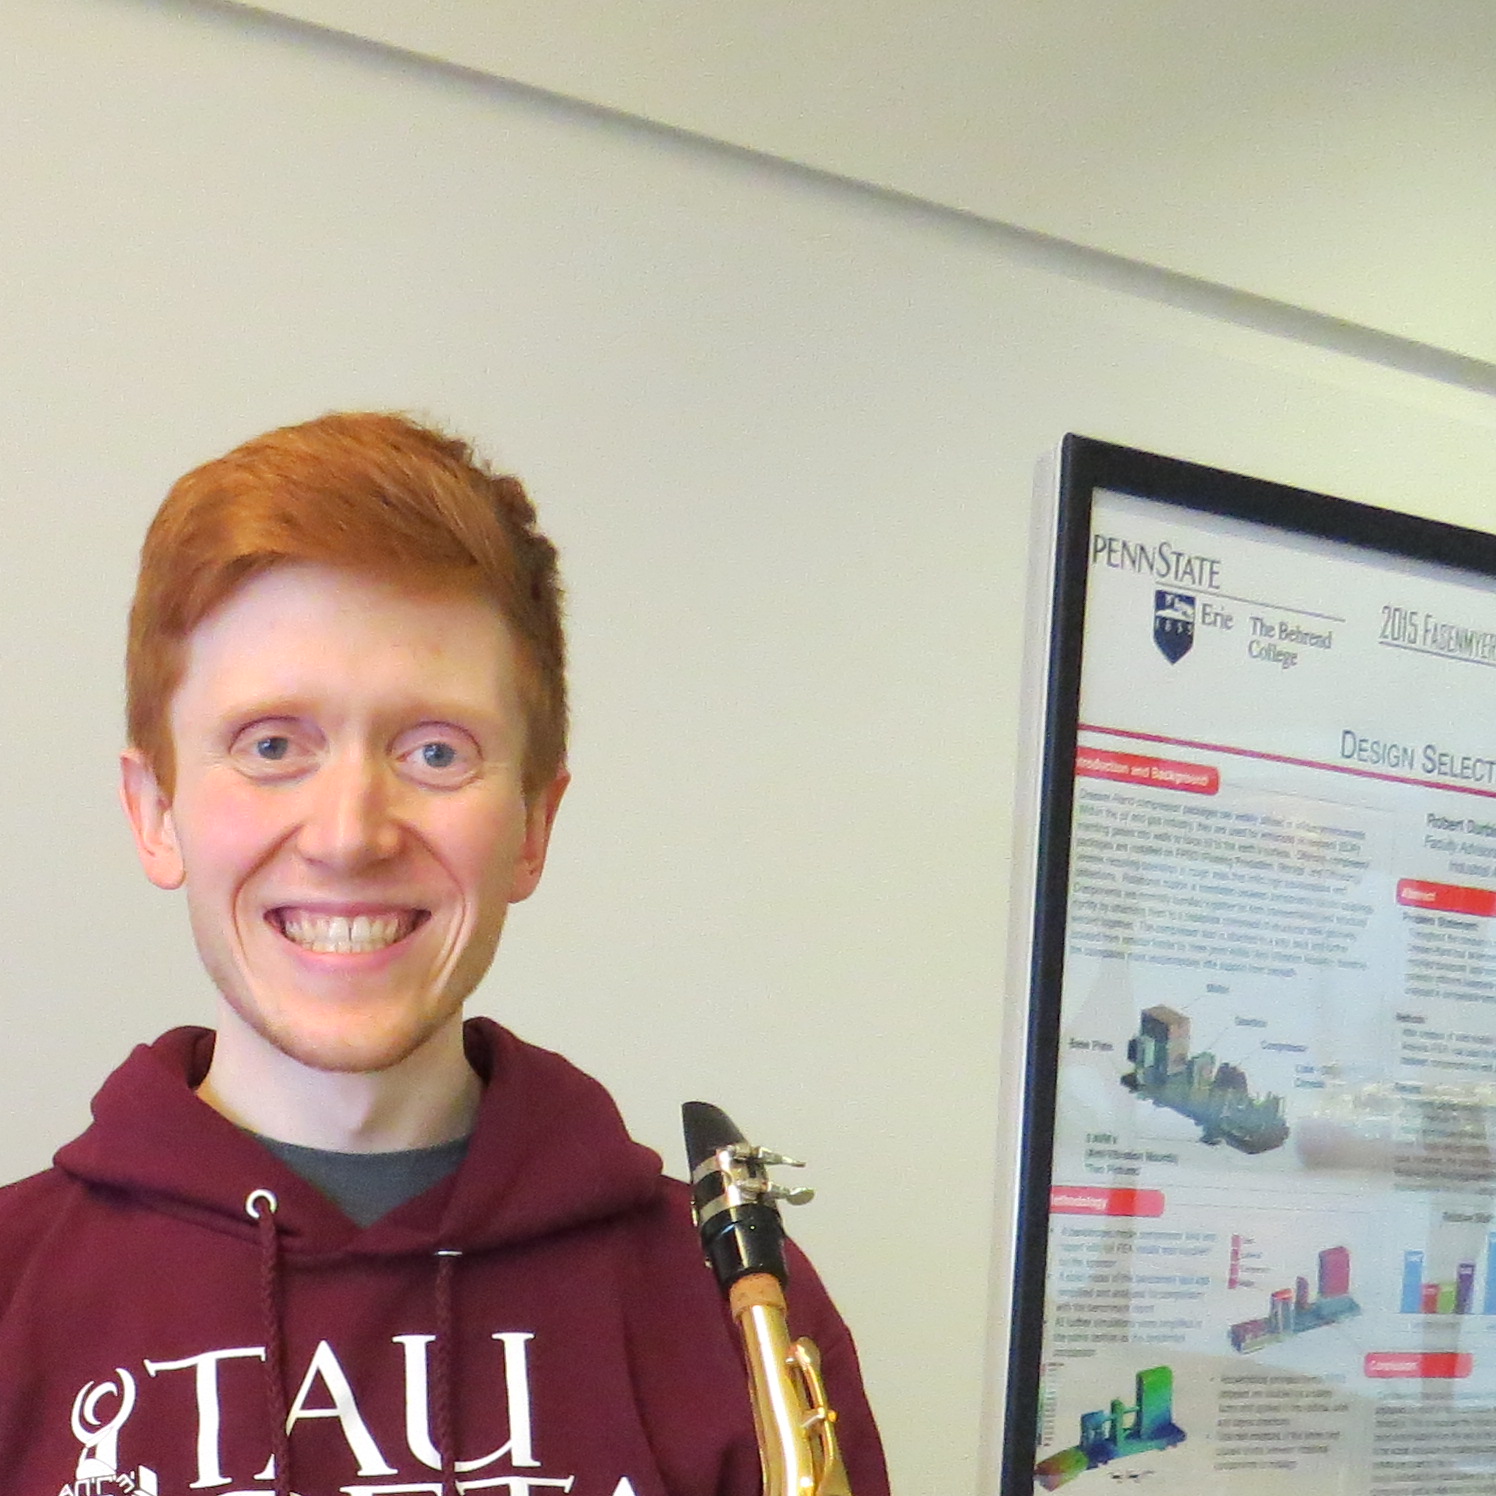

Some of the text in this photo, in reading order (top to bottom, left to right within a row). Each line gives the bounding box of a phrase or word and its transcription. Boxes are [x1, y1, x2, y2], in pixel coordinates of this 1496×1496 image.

[1201, 603, 1234, 630] Erie
[1249, 616, 1333, 650] The Behrend
[1379, 605, 1418, 645] 2015
[1248, 639, 1299, 670] College
[1340, 729, 1416, 771] DESIGN
[144, 1332, 541, 1490] TAU
